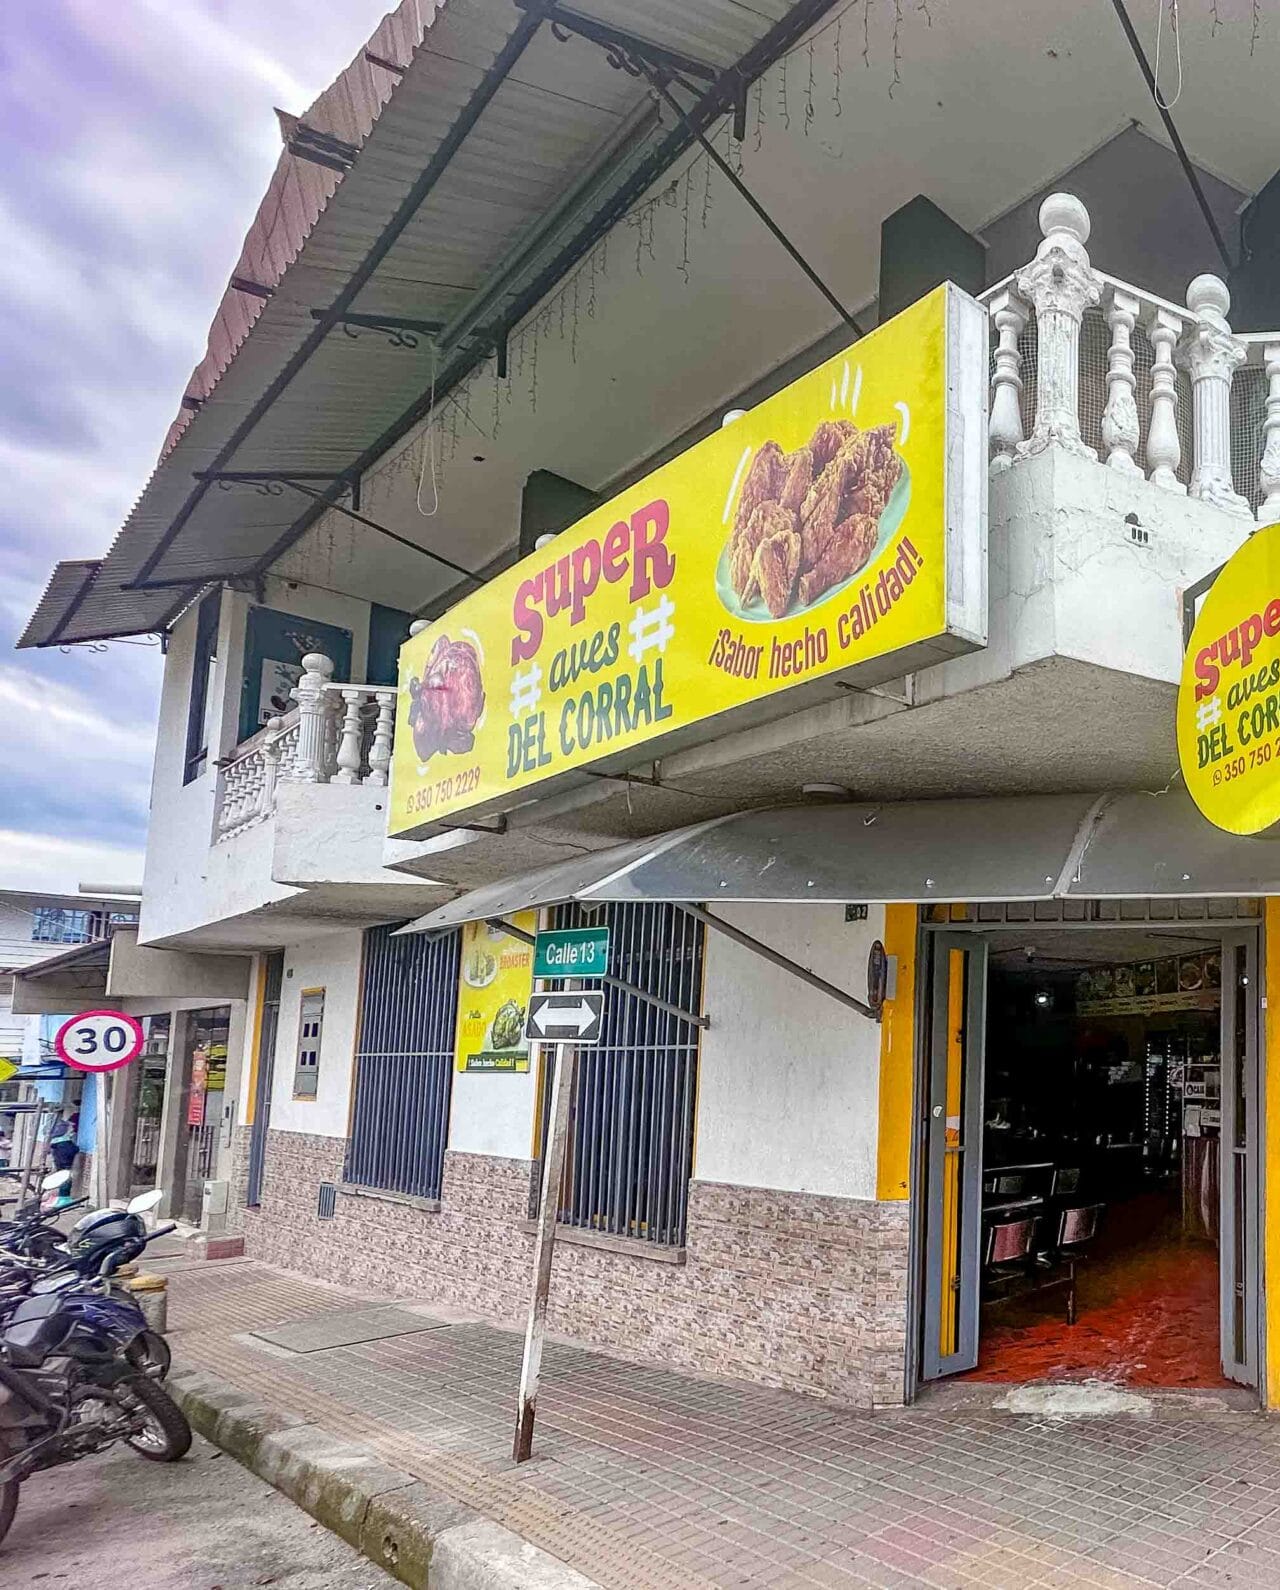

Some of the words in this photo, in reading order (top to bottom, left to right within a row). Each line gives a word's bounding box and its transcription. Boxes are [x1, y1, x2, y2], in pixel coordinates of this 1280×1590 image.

[708, 628, 763, 680] ¡Sabor
[768, 627, 828, 679] hecho
[837, 536, 924, 650] calidad!
[549, 622, 621, 695] aves
[507, 708, 553, 779] DEL
[560, 658, 674, 758] CORRAL
[1197, 723, 1234, 769] DEL
[1224, 759, 1246, 782] 350
[1249, 746, 1272, 770] 750
[415, 785, 433, 812] 350
[435, 777, 453, 805] 750
[455, 766, 481, 797] 2229
[546, 943, 578, 965] Calle
[580, 941, 595, 964] 13
[75, 1026, 127, 1054] 30
